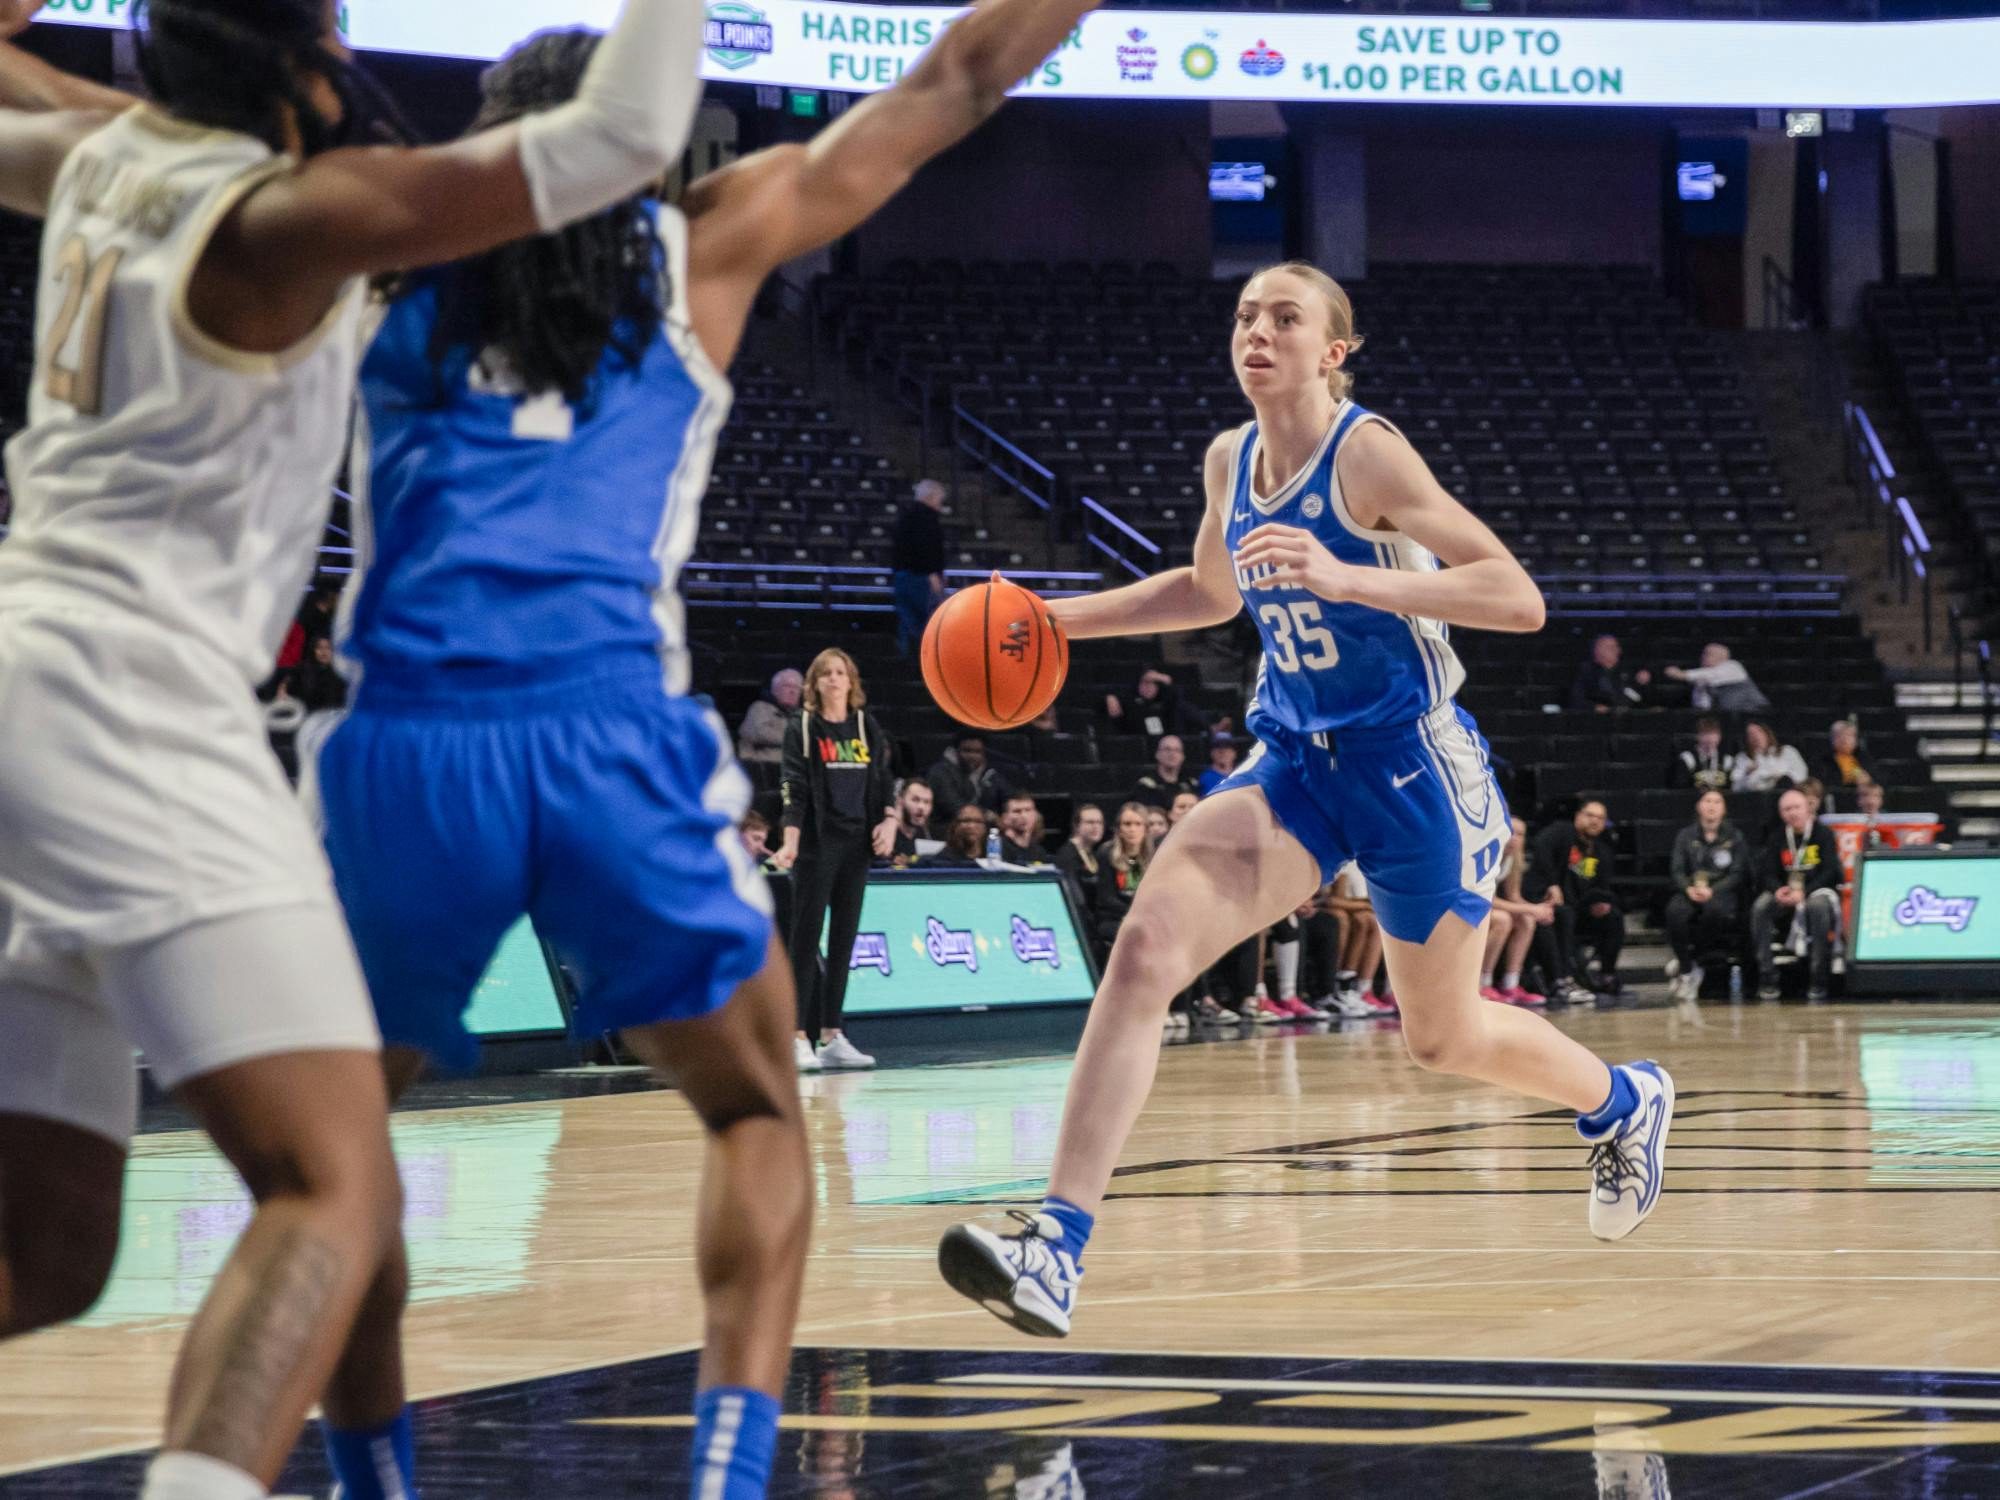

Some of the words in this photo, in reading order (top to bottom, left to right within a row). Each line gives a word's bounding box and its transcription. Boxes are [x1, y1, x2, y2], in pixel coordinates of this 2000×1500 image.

[802, 11, 932, 46] HARRIS
[1356, 26, 1447, 53] SAVE
[1457, 28, 1505, 55] UP
[1512, 28, 1561, 56] TO
[1302, 62, 1388, 90] $1.00
[1401, 65, 1467, 91] PER
[1477, 66, 1623, 94] GALLON
[1258, 600, 1341, 674] 35
[1471, 838, 1500, 884] D
